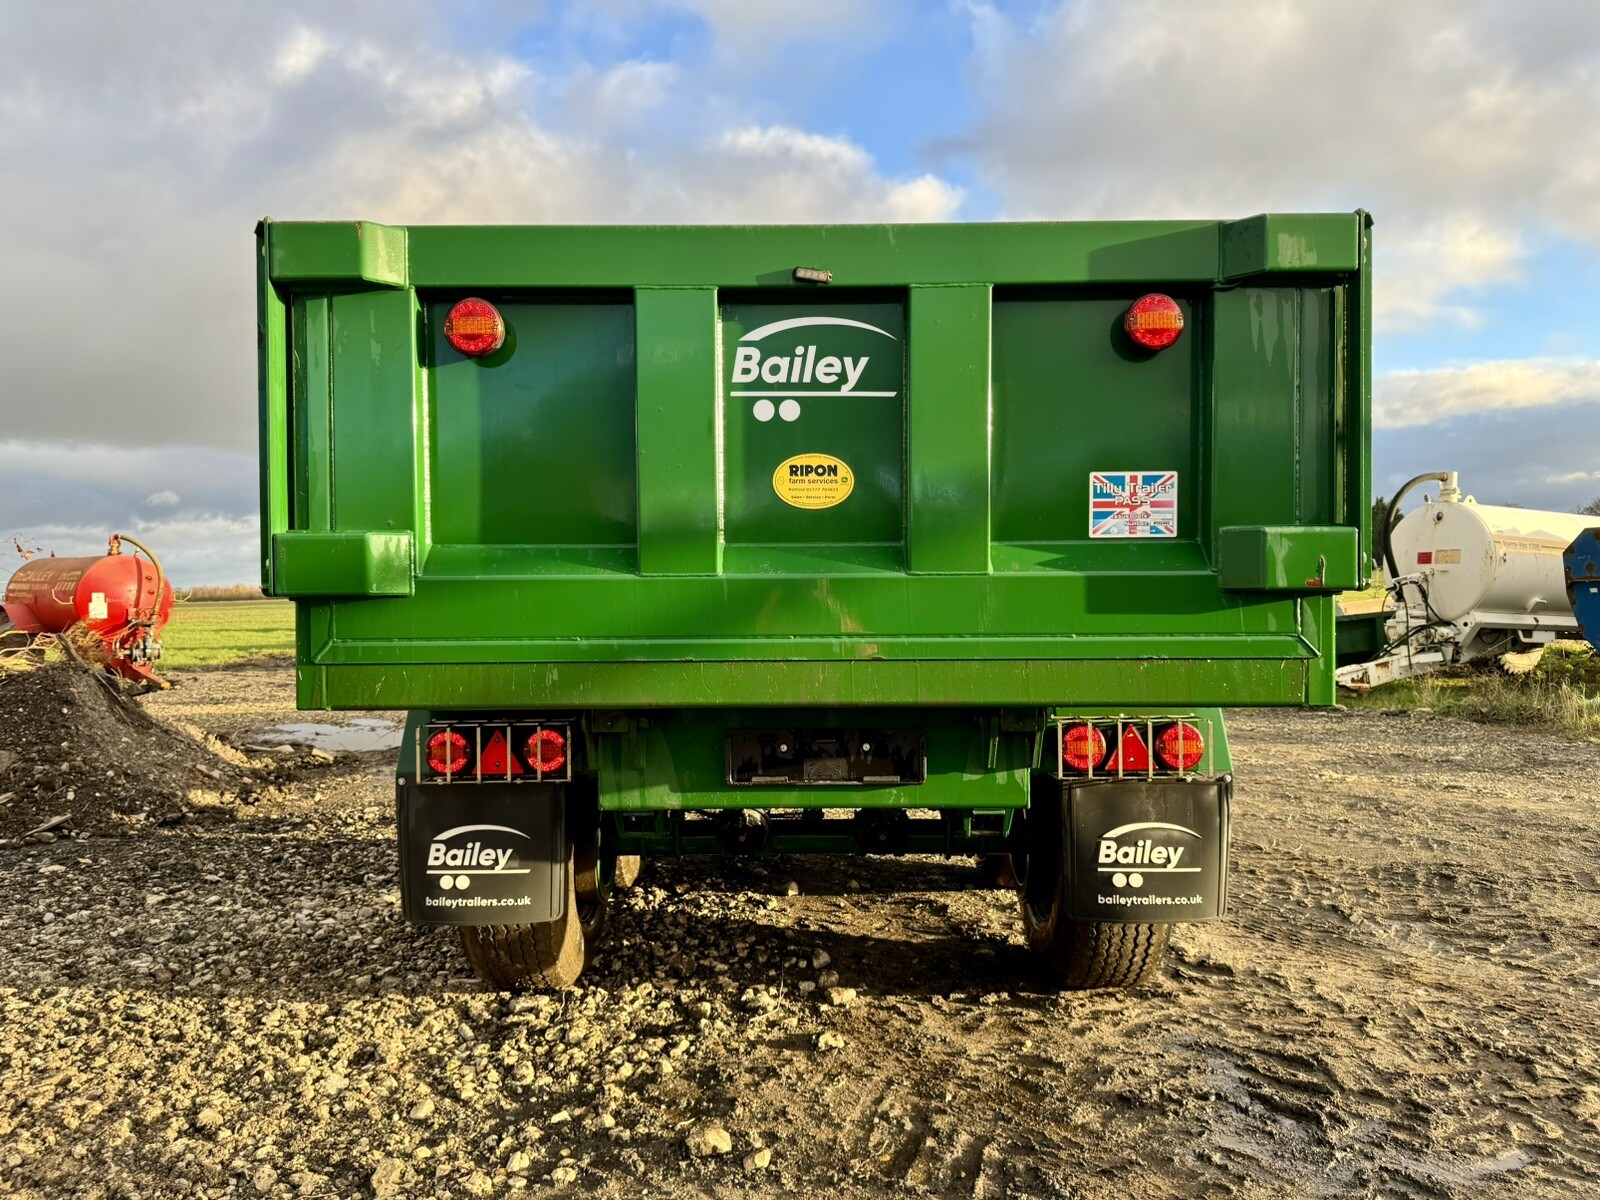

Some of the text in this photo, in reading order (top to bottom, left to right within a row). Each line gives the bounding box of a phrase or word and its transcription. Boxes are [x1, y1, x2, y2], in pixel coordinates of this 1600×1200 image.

[731, 345, 870, 392] Bailey
[789, 464, 837, 477] RIPON
[807, 477, 839, 485] services
[1093, 481, 1172, 495] Tilly Trailer
[1114, 496, 1151, 506] PASS
[427, 842, 513, 870] Bailey
[1098, 839, 1184, 869] Bailey
[425, 896, 531, 908] baileytrailers.co.uk
[1097, 895, 1203, 907] baileytrailers.co.uk
